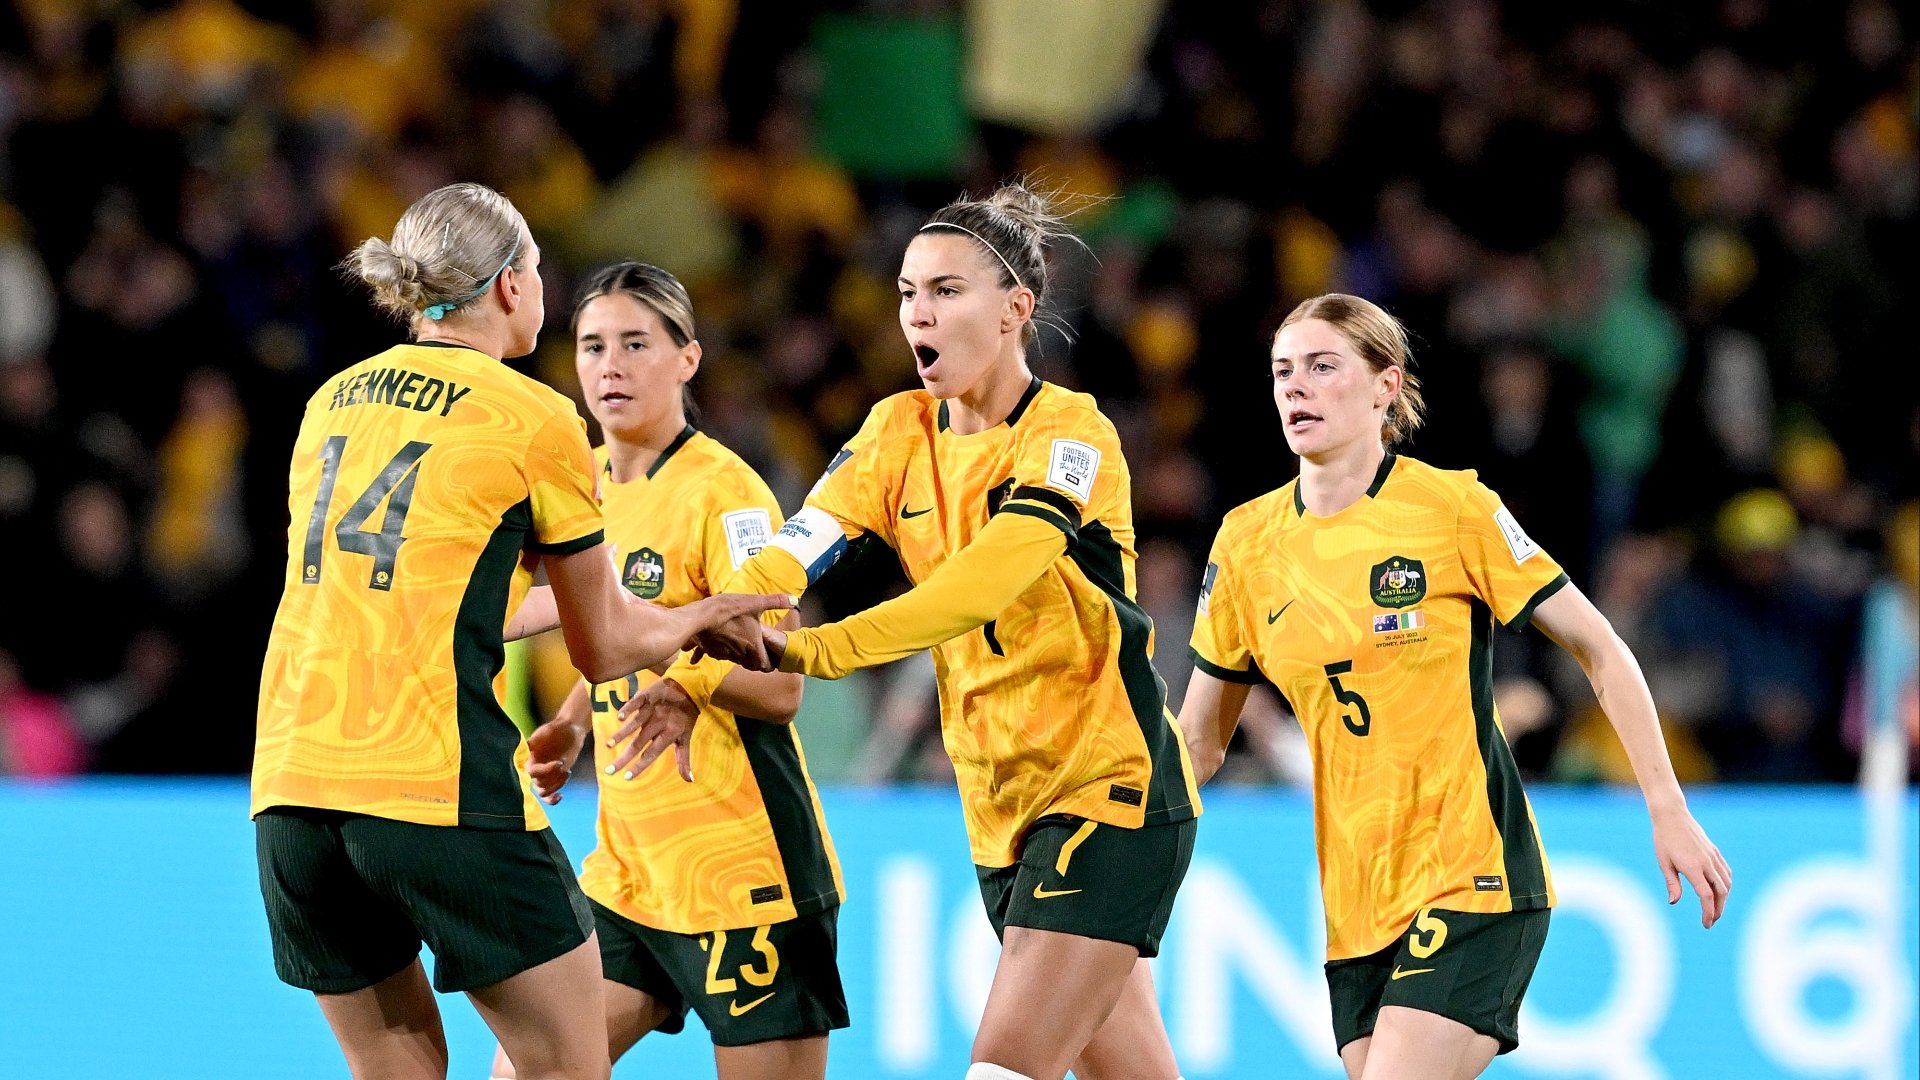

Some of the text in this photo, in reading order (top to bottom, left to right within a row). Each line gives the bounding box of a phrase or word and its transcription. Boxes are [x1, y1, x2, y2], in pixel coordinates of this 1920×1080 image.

[329, 368, 472, 417] KENNEDY
[1062, 453, 1090, 471] UNITES
[1063, 446, 1090, 461] FOOTBALL
[302, 435, 433, 591] 14
[737, 526, 765, 539] UNITES
[1324, 659, 1371, 736] 5
[1409, 908, 1448, 959] 5
[699, 925, 780, 994] 23
[1740, 857, 1907, 1072] 6
